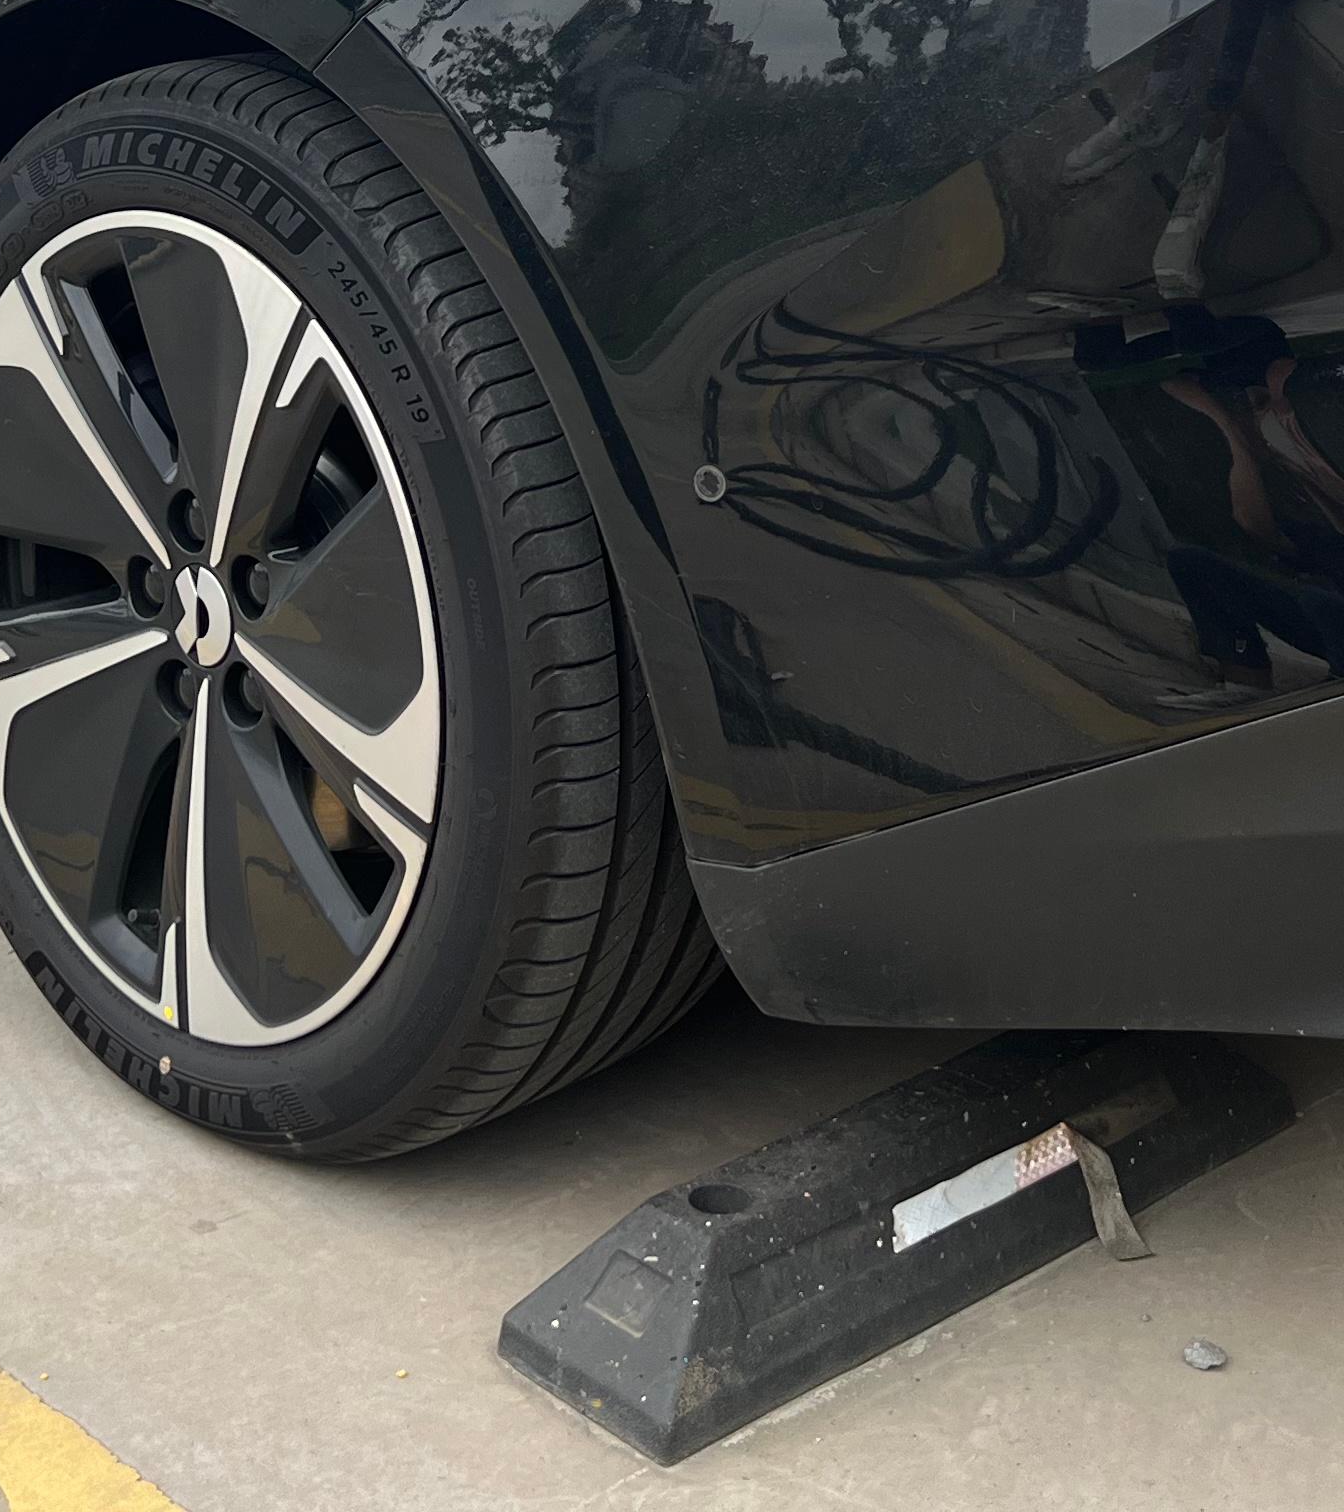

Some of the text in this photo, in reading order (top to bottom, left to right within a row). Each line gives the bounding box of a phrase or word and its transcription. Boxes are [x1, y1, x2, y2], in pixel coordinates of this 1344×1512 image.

[79, 129, 309, 240] MICHELIN
[327, 259, 400, 356] 245/45
[405, 393, 431, 424] 19
[35, 966, 244, 1129] MICHELIN
